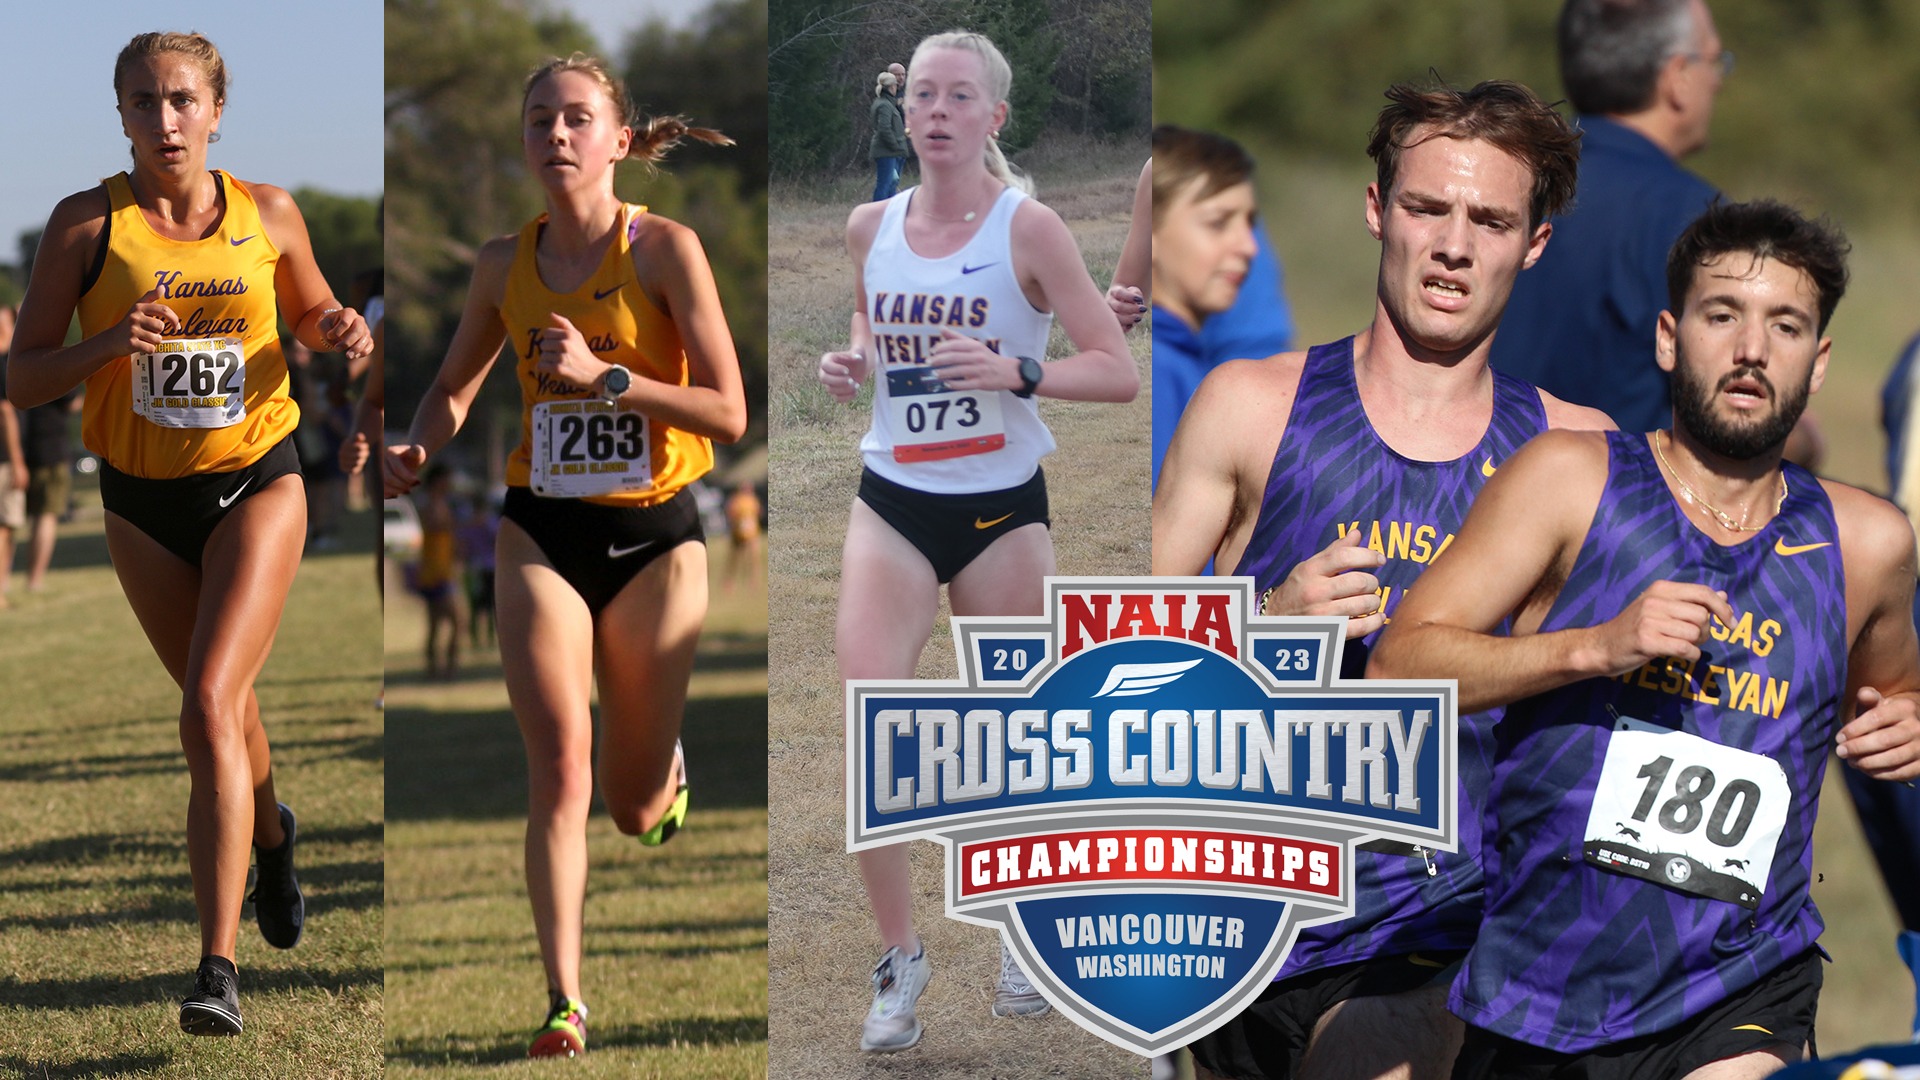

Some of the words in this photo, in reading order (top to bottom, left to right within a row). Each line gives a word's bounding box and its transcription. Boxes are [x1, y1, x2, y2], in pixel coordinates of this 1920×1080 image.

[154, 270, 249, 299] Kansas
[156, 307, 249, 339] esleyan
[874, 293, 988, 328] KANSAS
[154, 341, 185, 354] ICHITA
[214, 339, 226, 350] XC
[151, 397, 164, 409] JK
[166, 397, 189, 408] GOLD
[191, 396, 228, 408] CLASSIC
[906, 396, 981, 433] 073
[1630, 755, 1762, 848] 180
